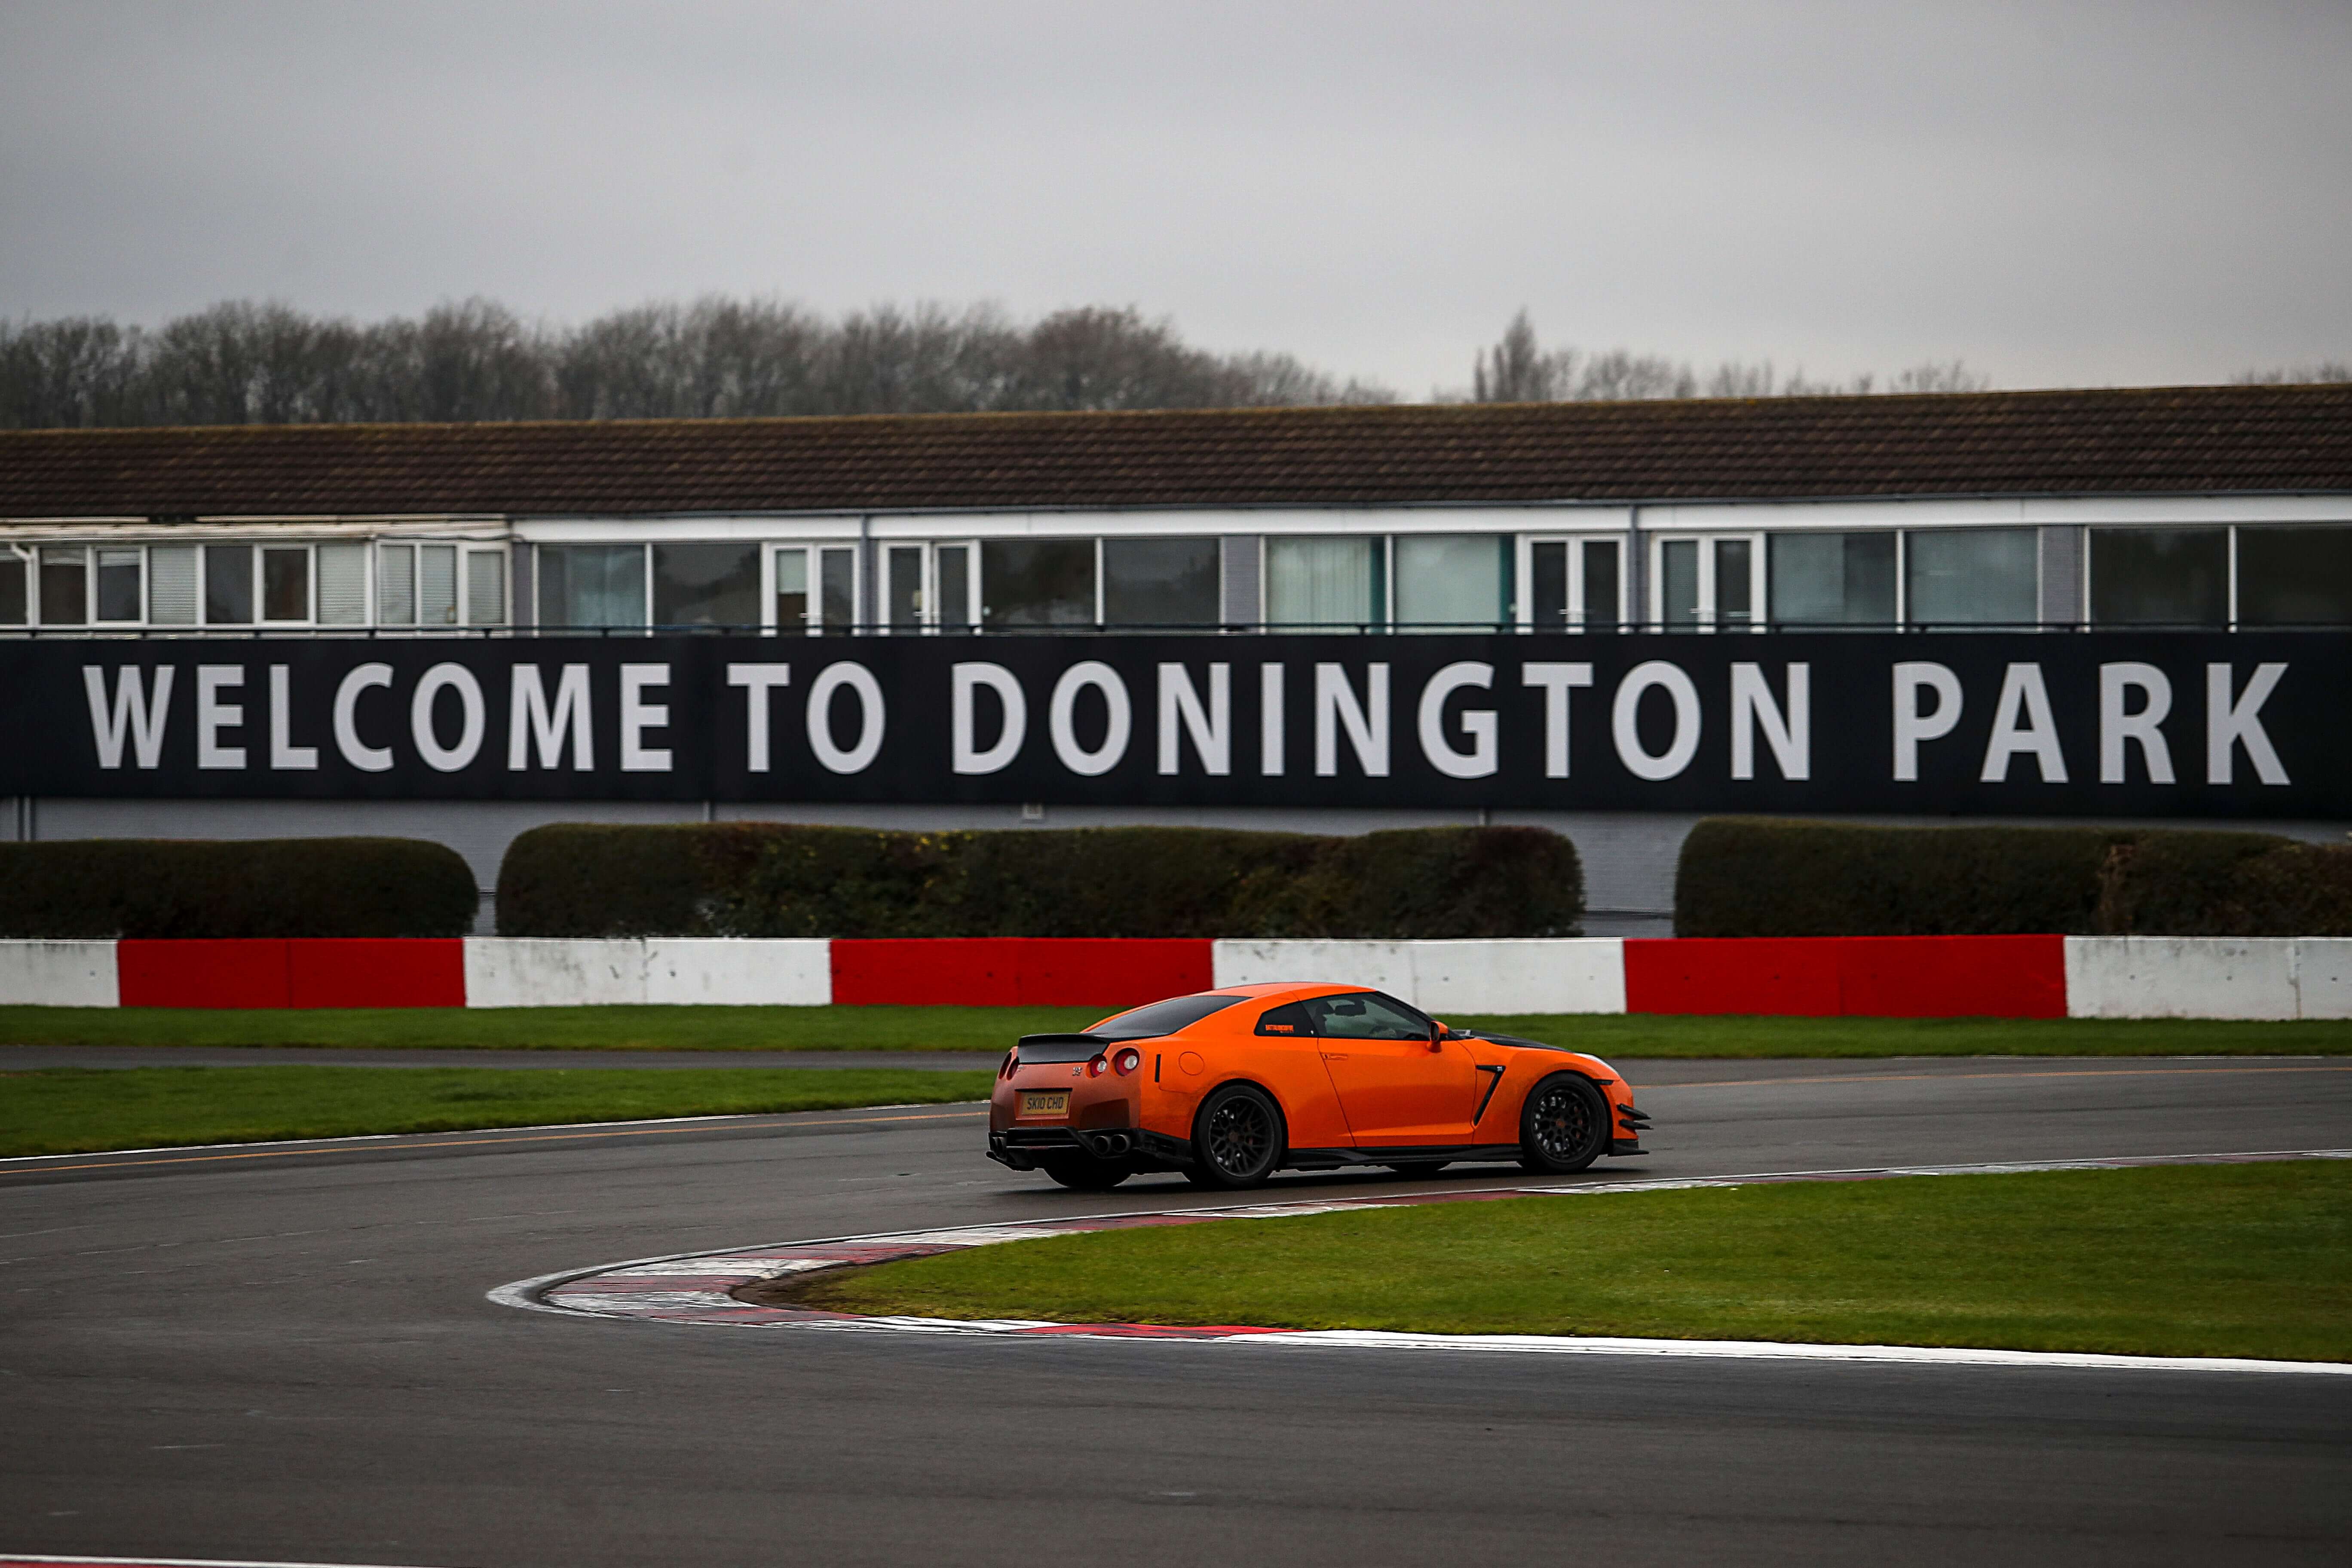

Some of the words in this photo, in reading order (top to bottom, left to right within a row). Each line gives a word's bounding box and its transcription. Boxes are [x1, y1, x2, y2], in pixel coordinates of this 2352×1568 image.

[83, 663, 672, 772] WELCOME
[726, 661, 885, 774] TO
[952, 661, 1810, 781] DONINGTON
[1893, 662, 2289, 785] PARK
